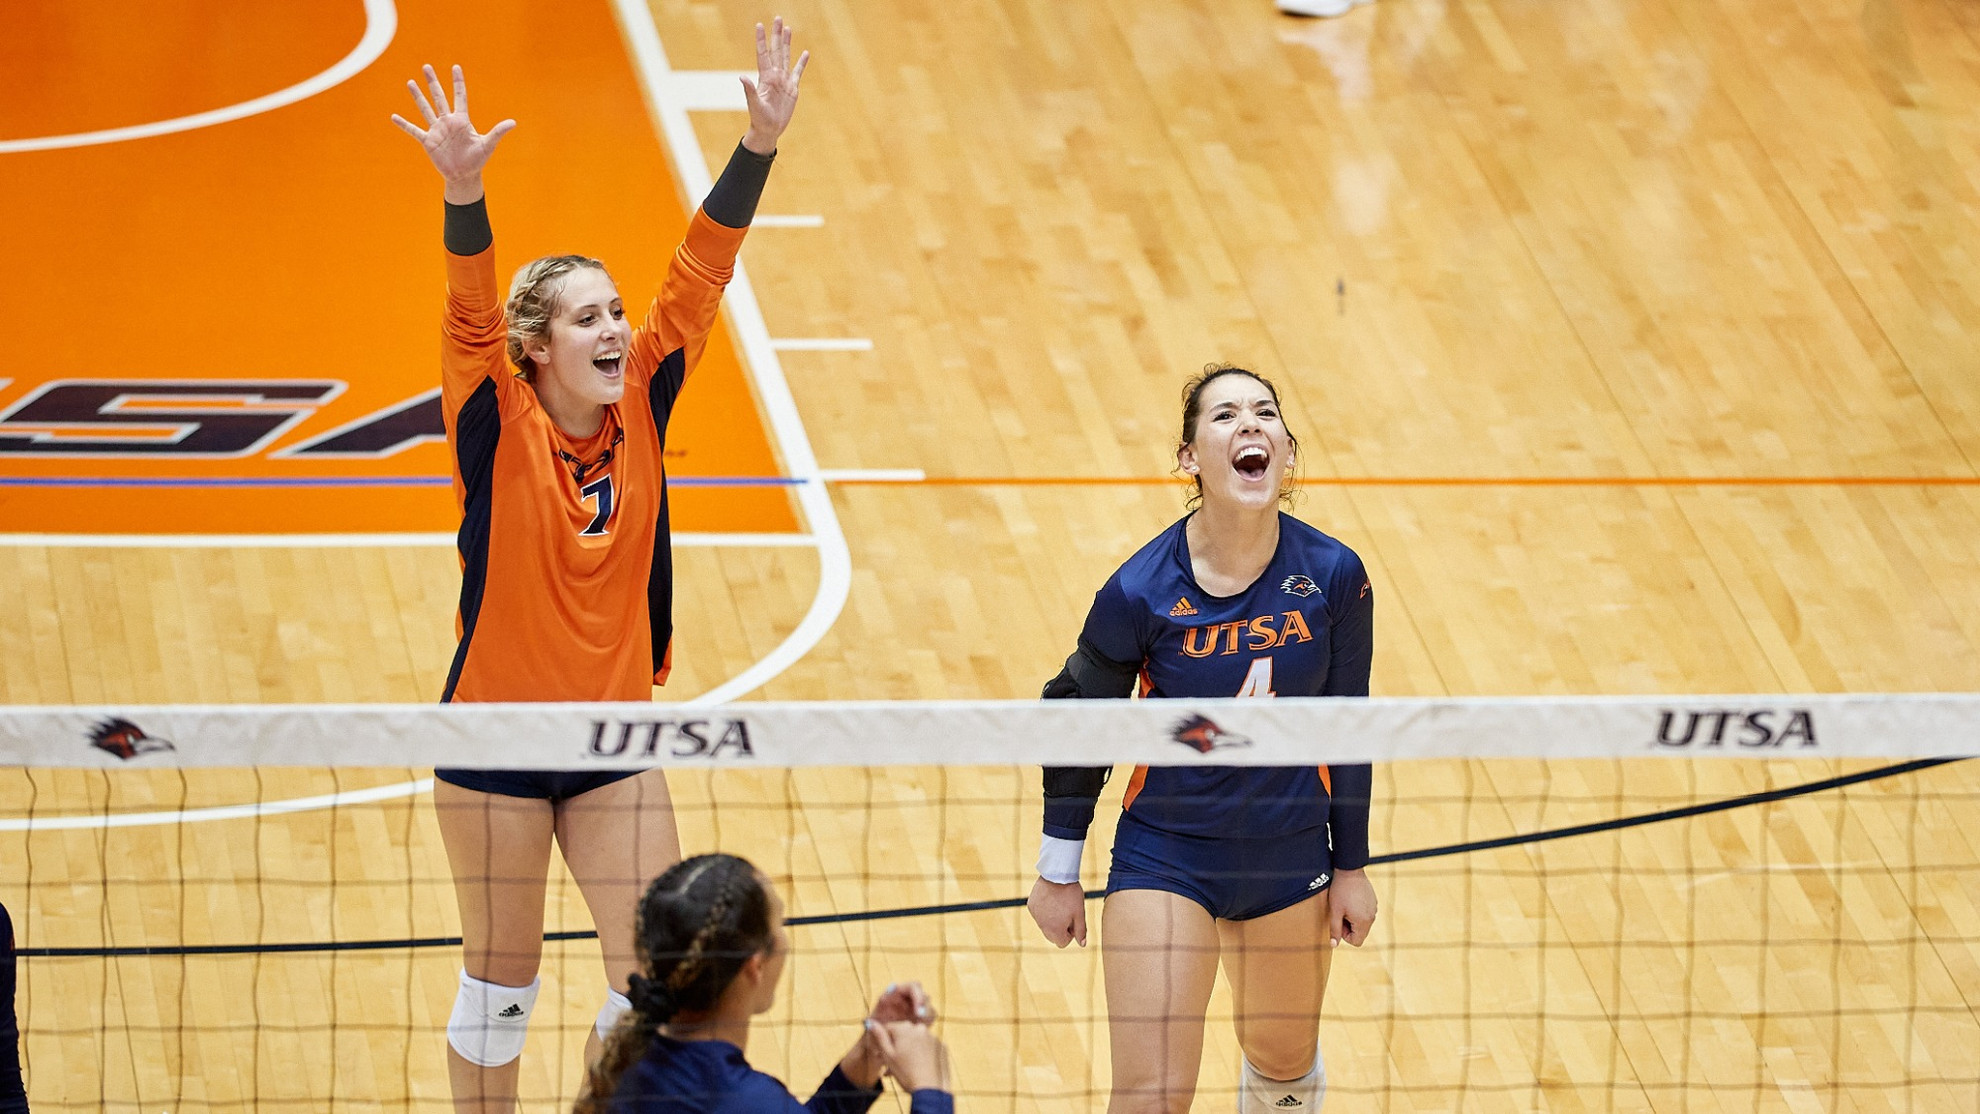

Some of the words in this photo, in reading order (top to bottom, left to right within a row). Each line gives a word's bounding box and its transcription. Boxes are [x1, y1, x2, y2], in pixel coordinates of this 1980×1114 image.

[578, 473, 614, 536] 7
[1169, 607, 1198, 616] adidas
[1182, 610, 1314, 658] UTSA
[1235, 655, 1277, 697] 4
[588, 719, 754, 756] UTSA
[1656, 709, 1818, 747] UTSA
